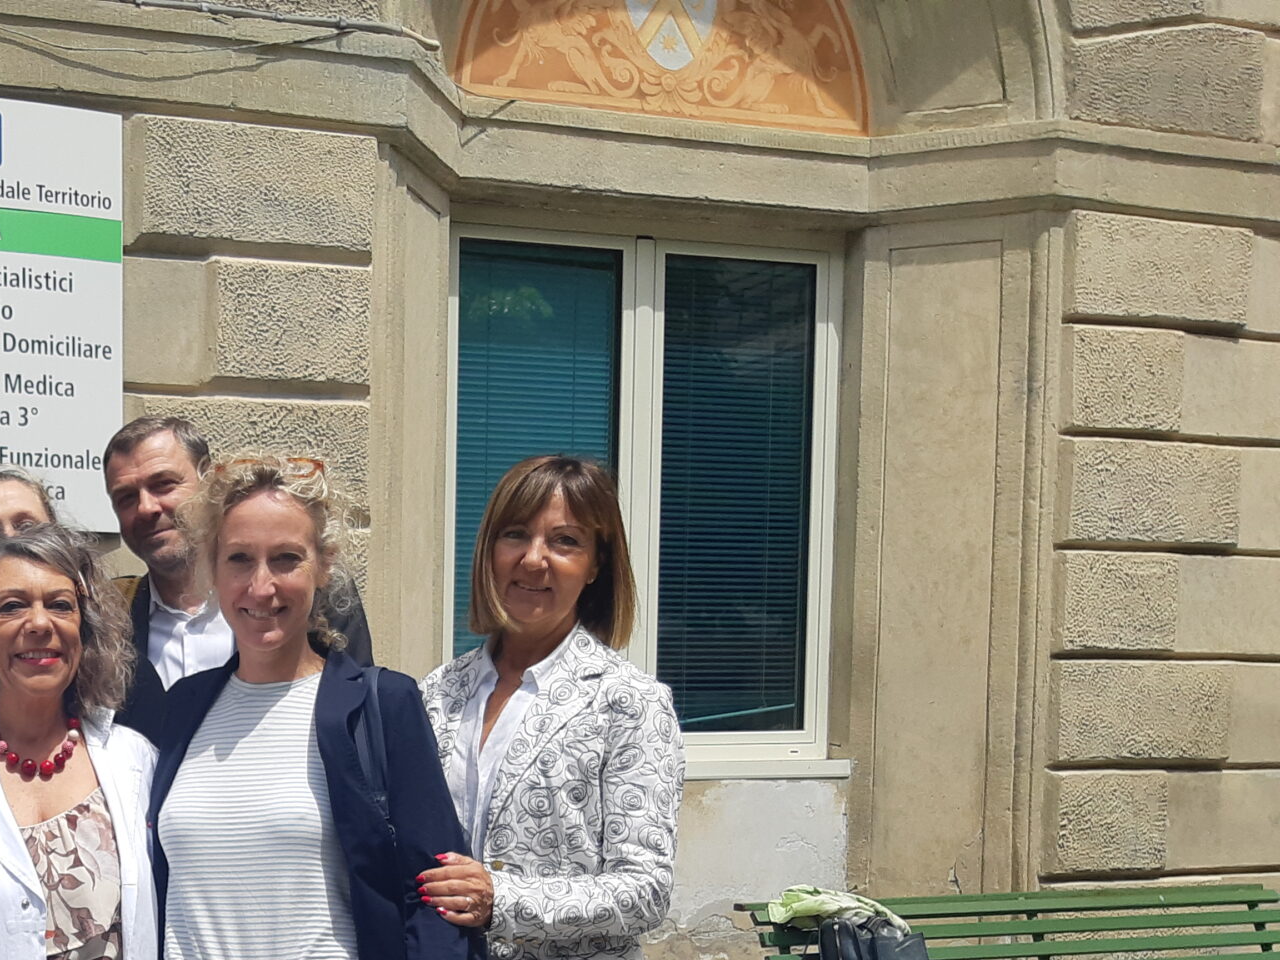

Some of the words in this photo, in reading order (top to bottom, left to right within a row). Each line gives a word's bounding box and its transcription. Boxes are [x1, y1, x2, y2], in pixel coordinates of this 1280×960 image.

[35, 184, 112, 210] Territorio
[3, 332, 112, 360] Domiciliare
[4, 373, 74, 397] Medica
[18, 406, 39, 427] 3°
